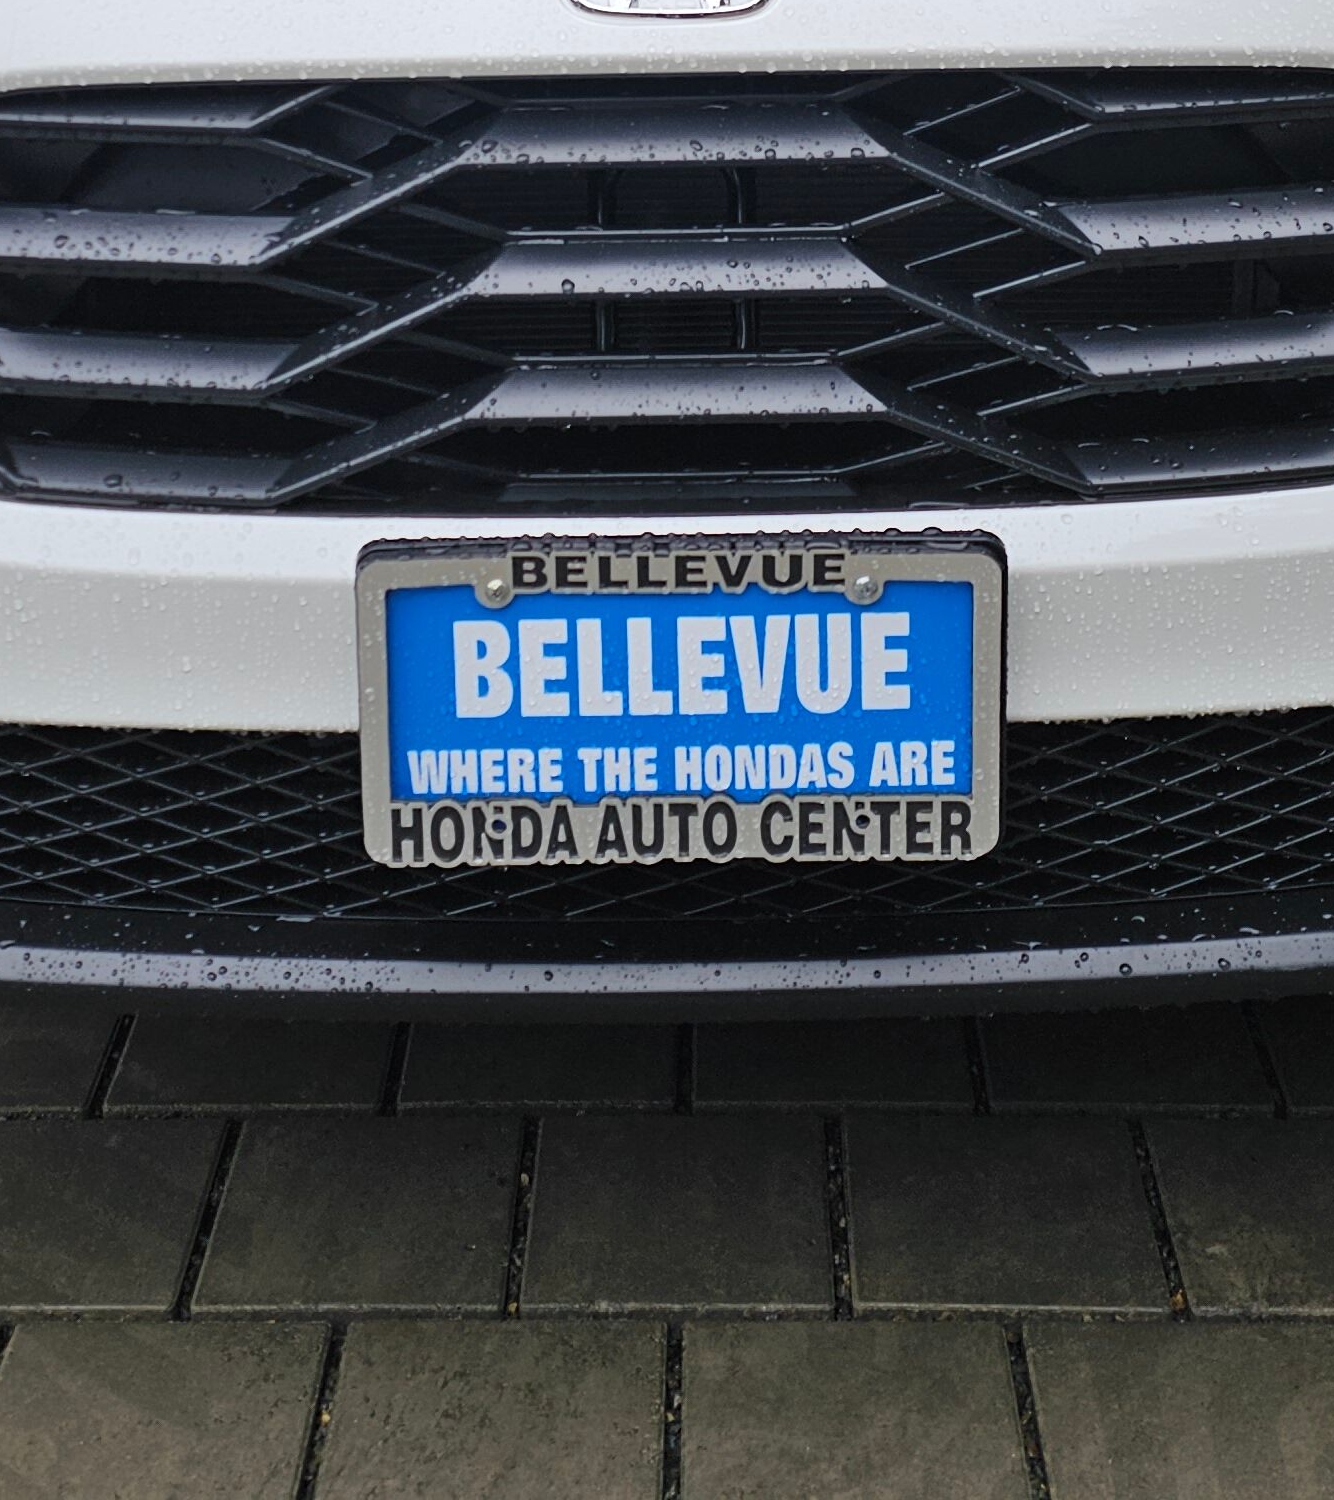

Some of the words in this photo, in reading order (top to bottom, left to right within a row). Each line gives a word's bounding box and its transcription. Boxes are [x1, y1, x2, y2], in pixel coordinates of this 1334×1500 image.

[511, 554, 845, 589] BELLEVUE
[452, 611, 911, 719] BELLEVUE
[407, 747, 563, 794] WHERE
[577, 747, 657, 793] THE
[675, 741, 855, 791] HONDAS
[869, 740, 956, 787] ARE
[390, 806, 576, 861] HONDA
[598, 802, 739, 859] AUTO
[760, 800, 973, 856] CENTER
